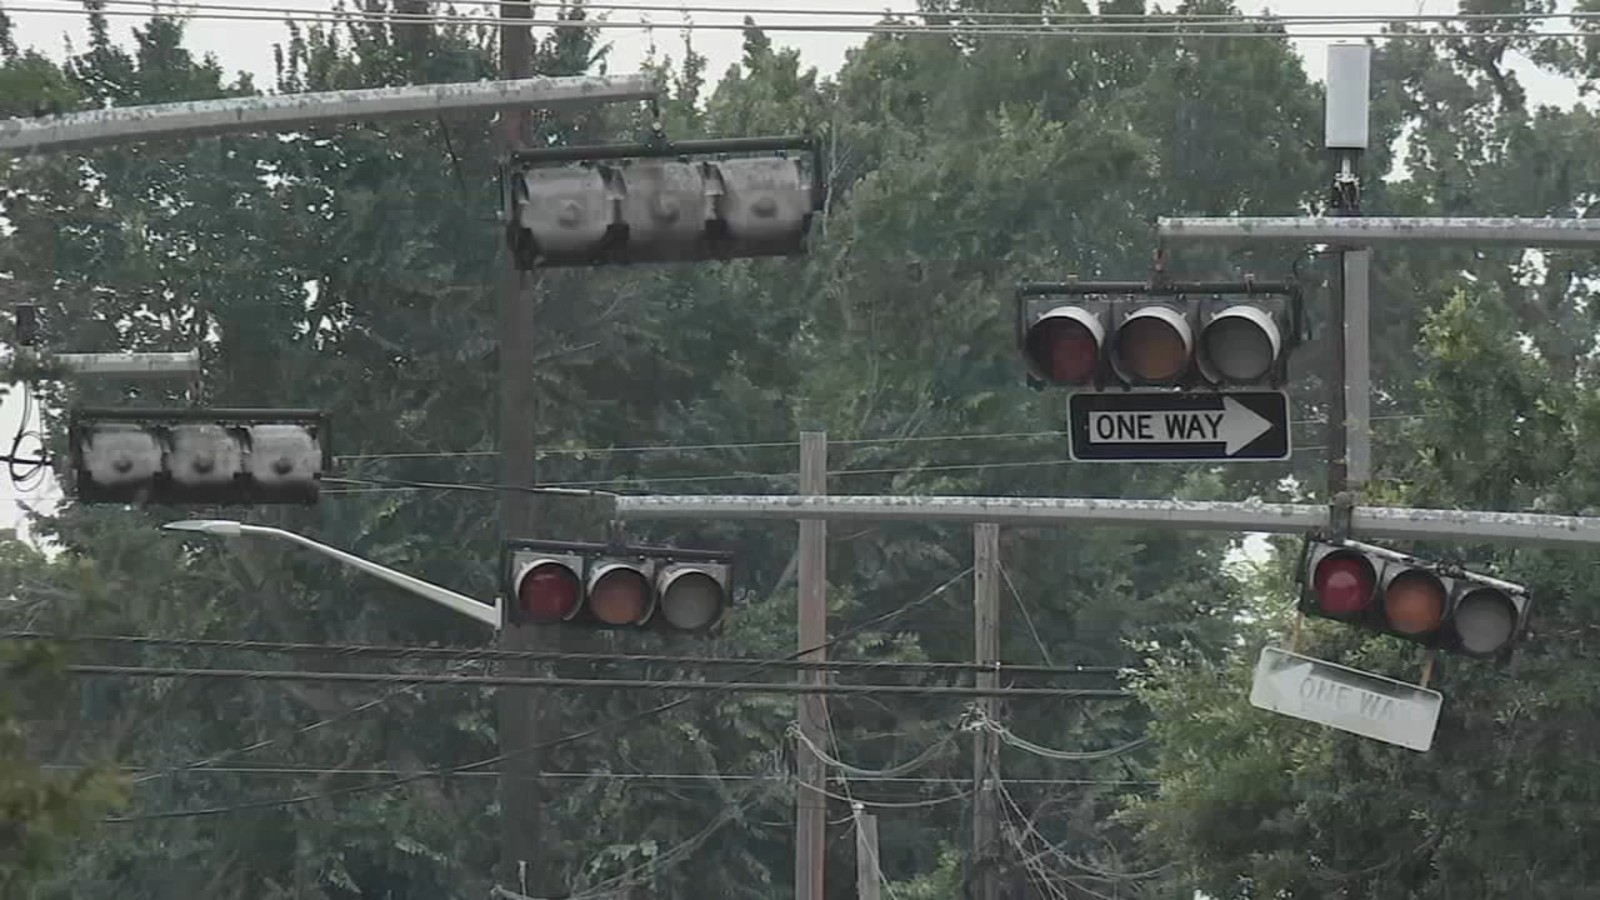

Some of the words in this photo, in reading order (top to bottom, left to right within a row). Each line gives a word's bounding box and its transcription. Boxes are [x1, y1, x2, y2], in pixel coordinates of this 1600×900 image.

[1096, 414, 1154, 440] ONE
[1164, 413, 1224, 439] WAY
[1300, 677, 1352, 709] ONE
[1359, 691, 1407, 723] WA
